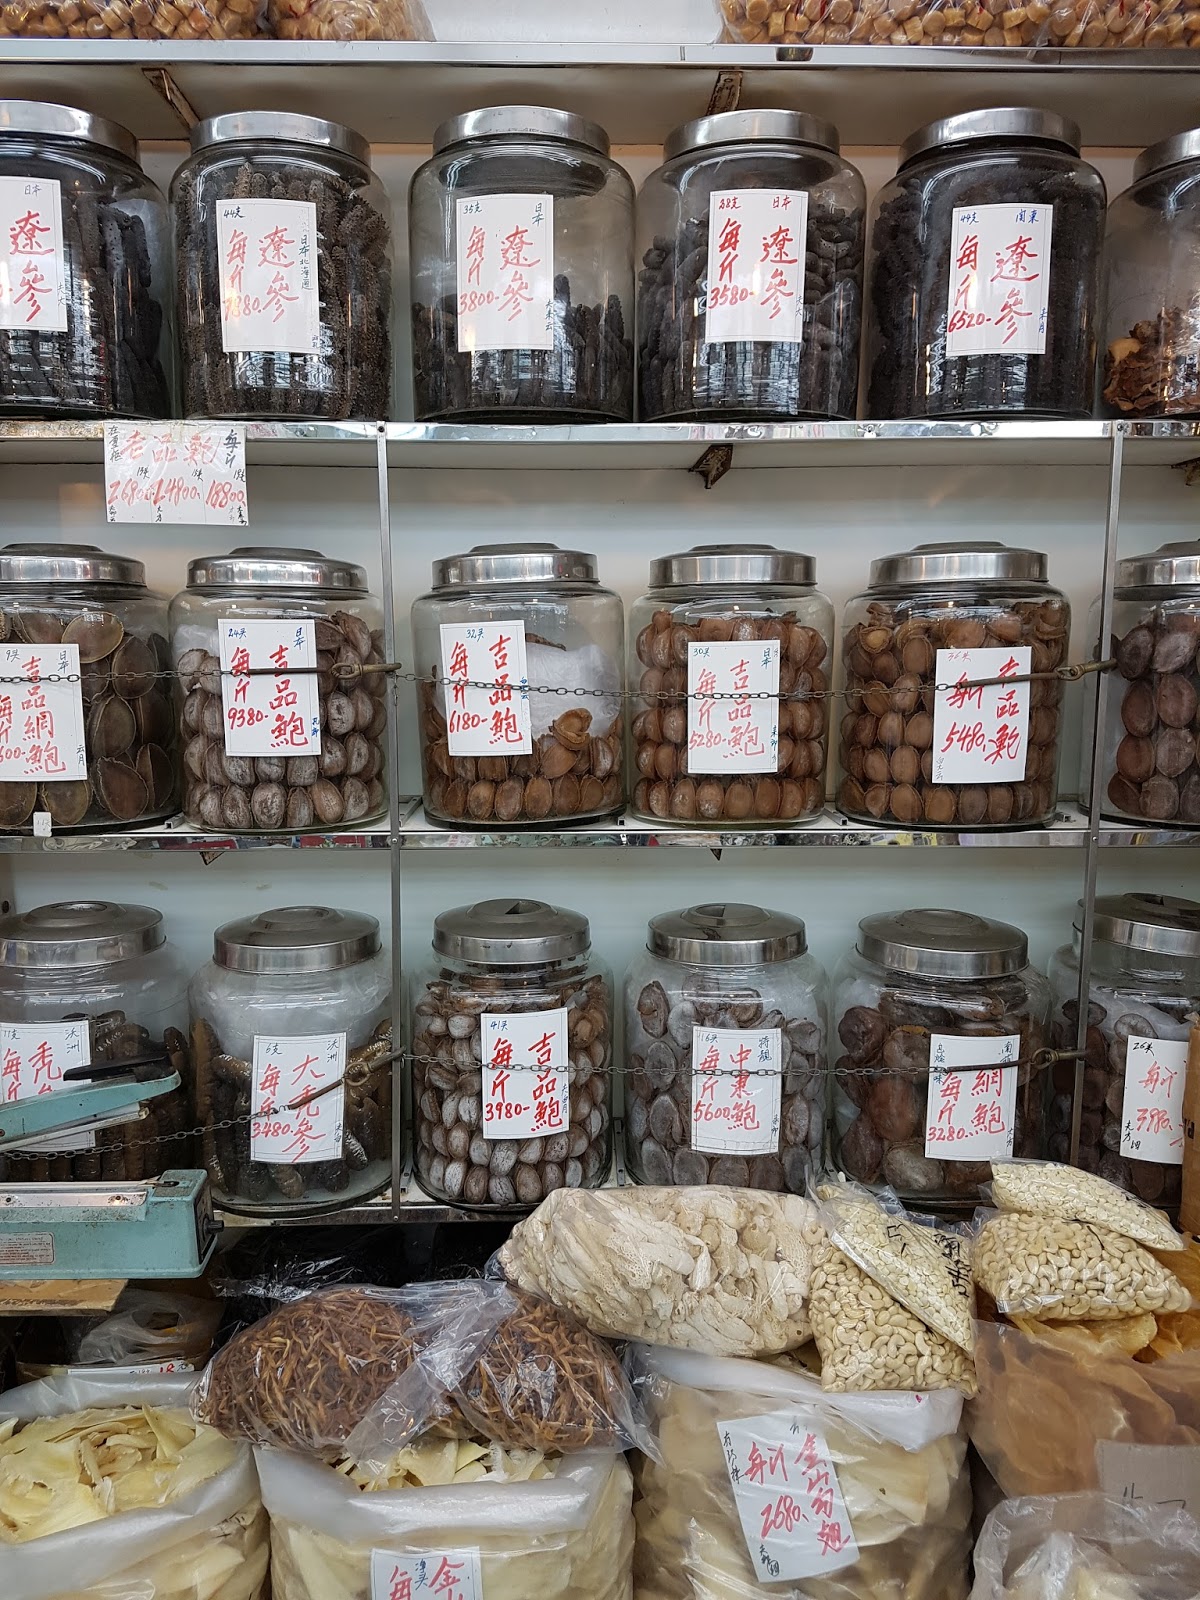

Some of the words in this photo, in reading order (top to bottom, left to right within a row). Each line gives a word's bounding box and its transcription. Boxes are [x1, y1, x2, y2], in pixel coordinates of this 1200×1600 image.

[24, 184, 42, 197] 日本
[772, 195, 792, 210] 日本
[293, 627, 306, 650] 日本
[57, 650, 69, 673] 日本
[761, 647, 772, 669] 日本
[489, 634, 523, 745] 吉品鮑
[723, 659, 765, 758] 吉品鮑
[528, 1032, 563, 1132] 吉品鮑
